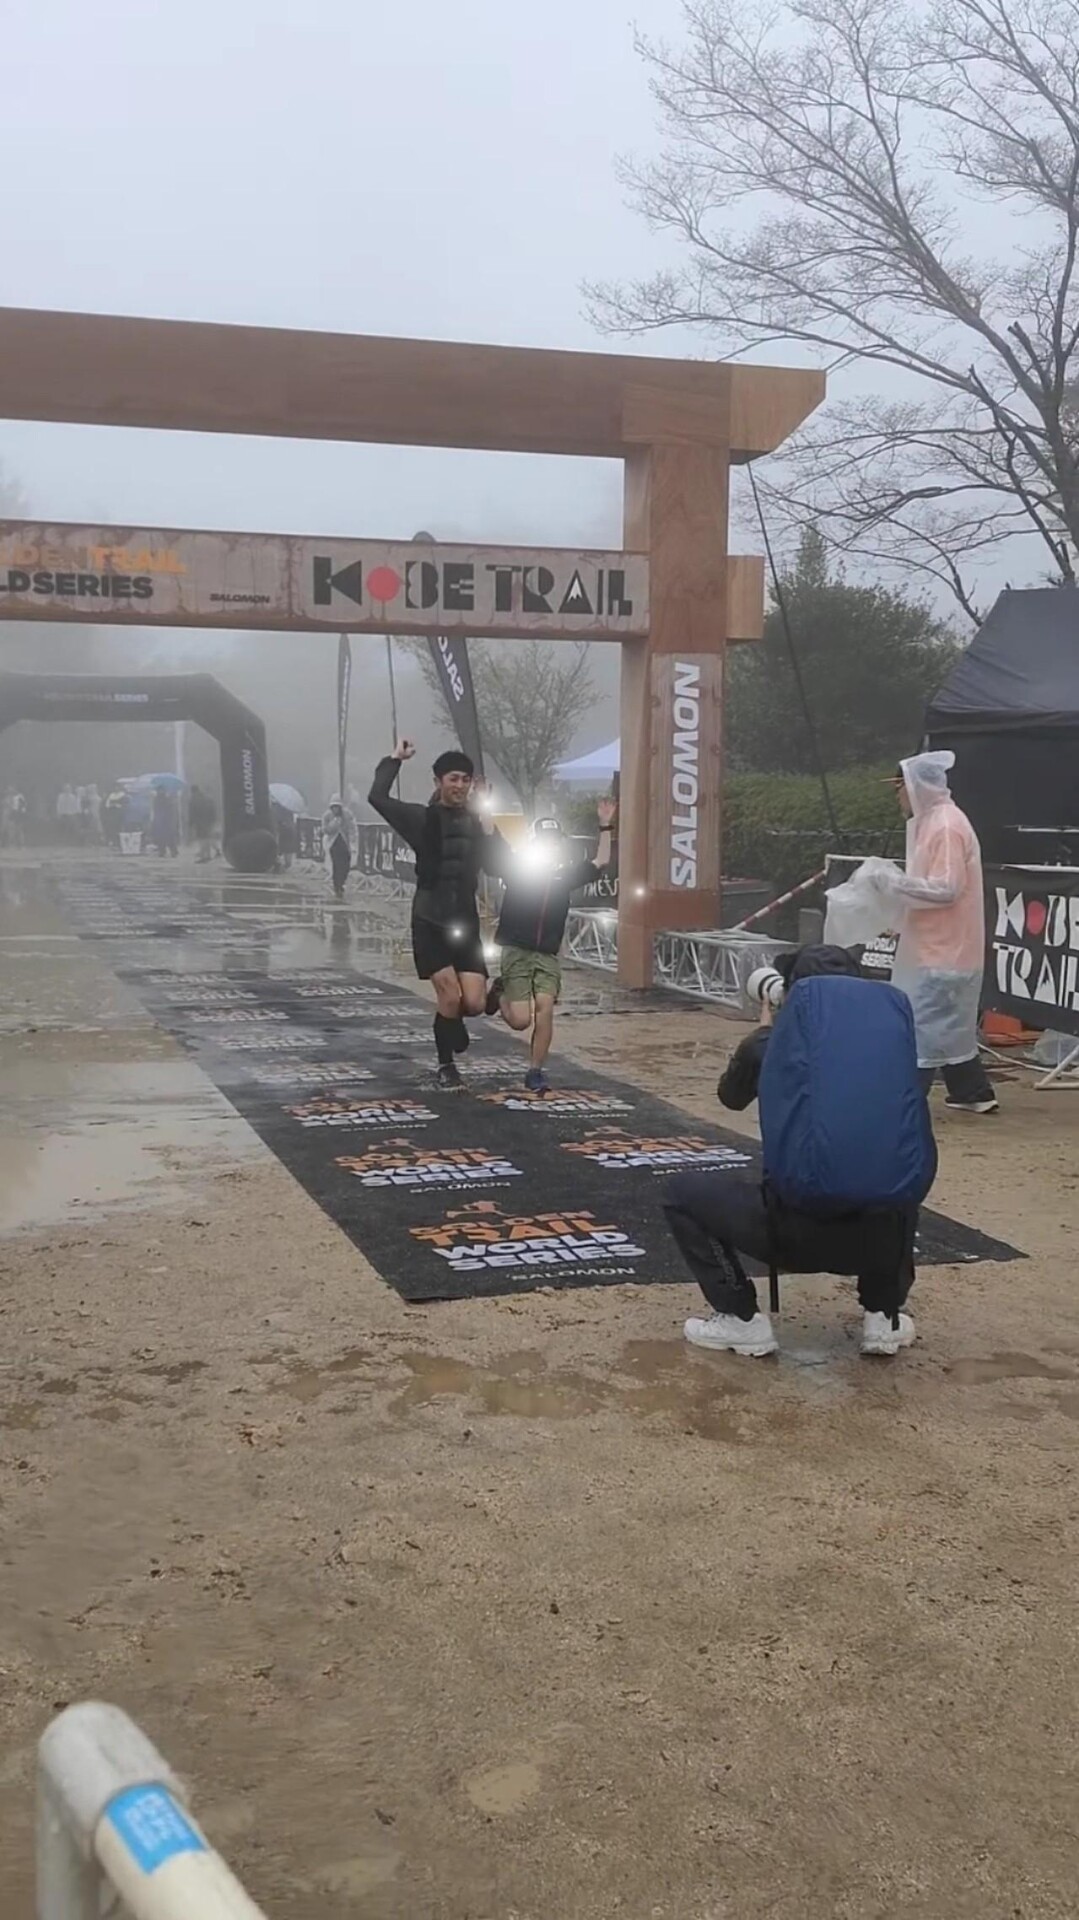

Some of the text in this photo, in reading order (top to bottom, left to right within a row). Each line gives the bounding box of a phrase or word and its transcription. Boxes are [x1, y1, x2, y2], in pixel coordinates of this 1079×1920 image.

[209, 592, 271, 604] SALOMON
[313, 556, 633, 616] KOBE TRAIL
[241, 749, 256, 816] SALOMON
[671, 662, 701, 889] SALOMON
[350, 1160, 513, 1177] WORLD
[361, 1168, 524, 1187] SERIES
[409, 1209, 596, 1236] GOLDEN
[415, 1219, 619, 1247] TRAIL
[432, 1231, 629, 1259] WORLD
[448, 1244, 647, 1271] SERIES
[507, 1267, 636, 1281] SALOMON
